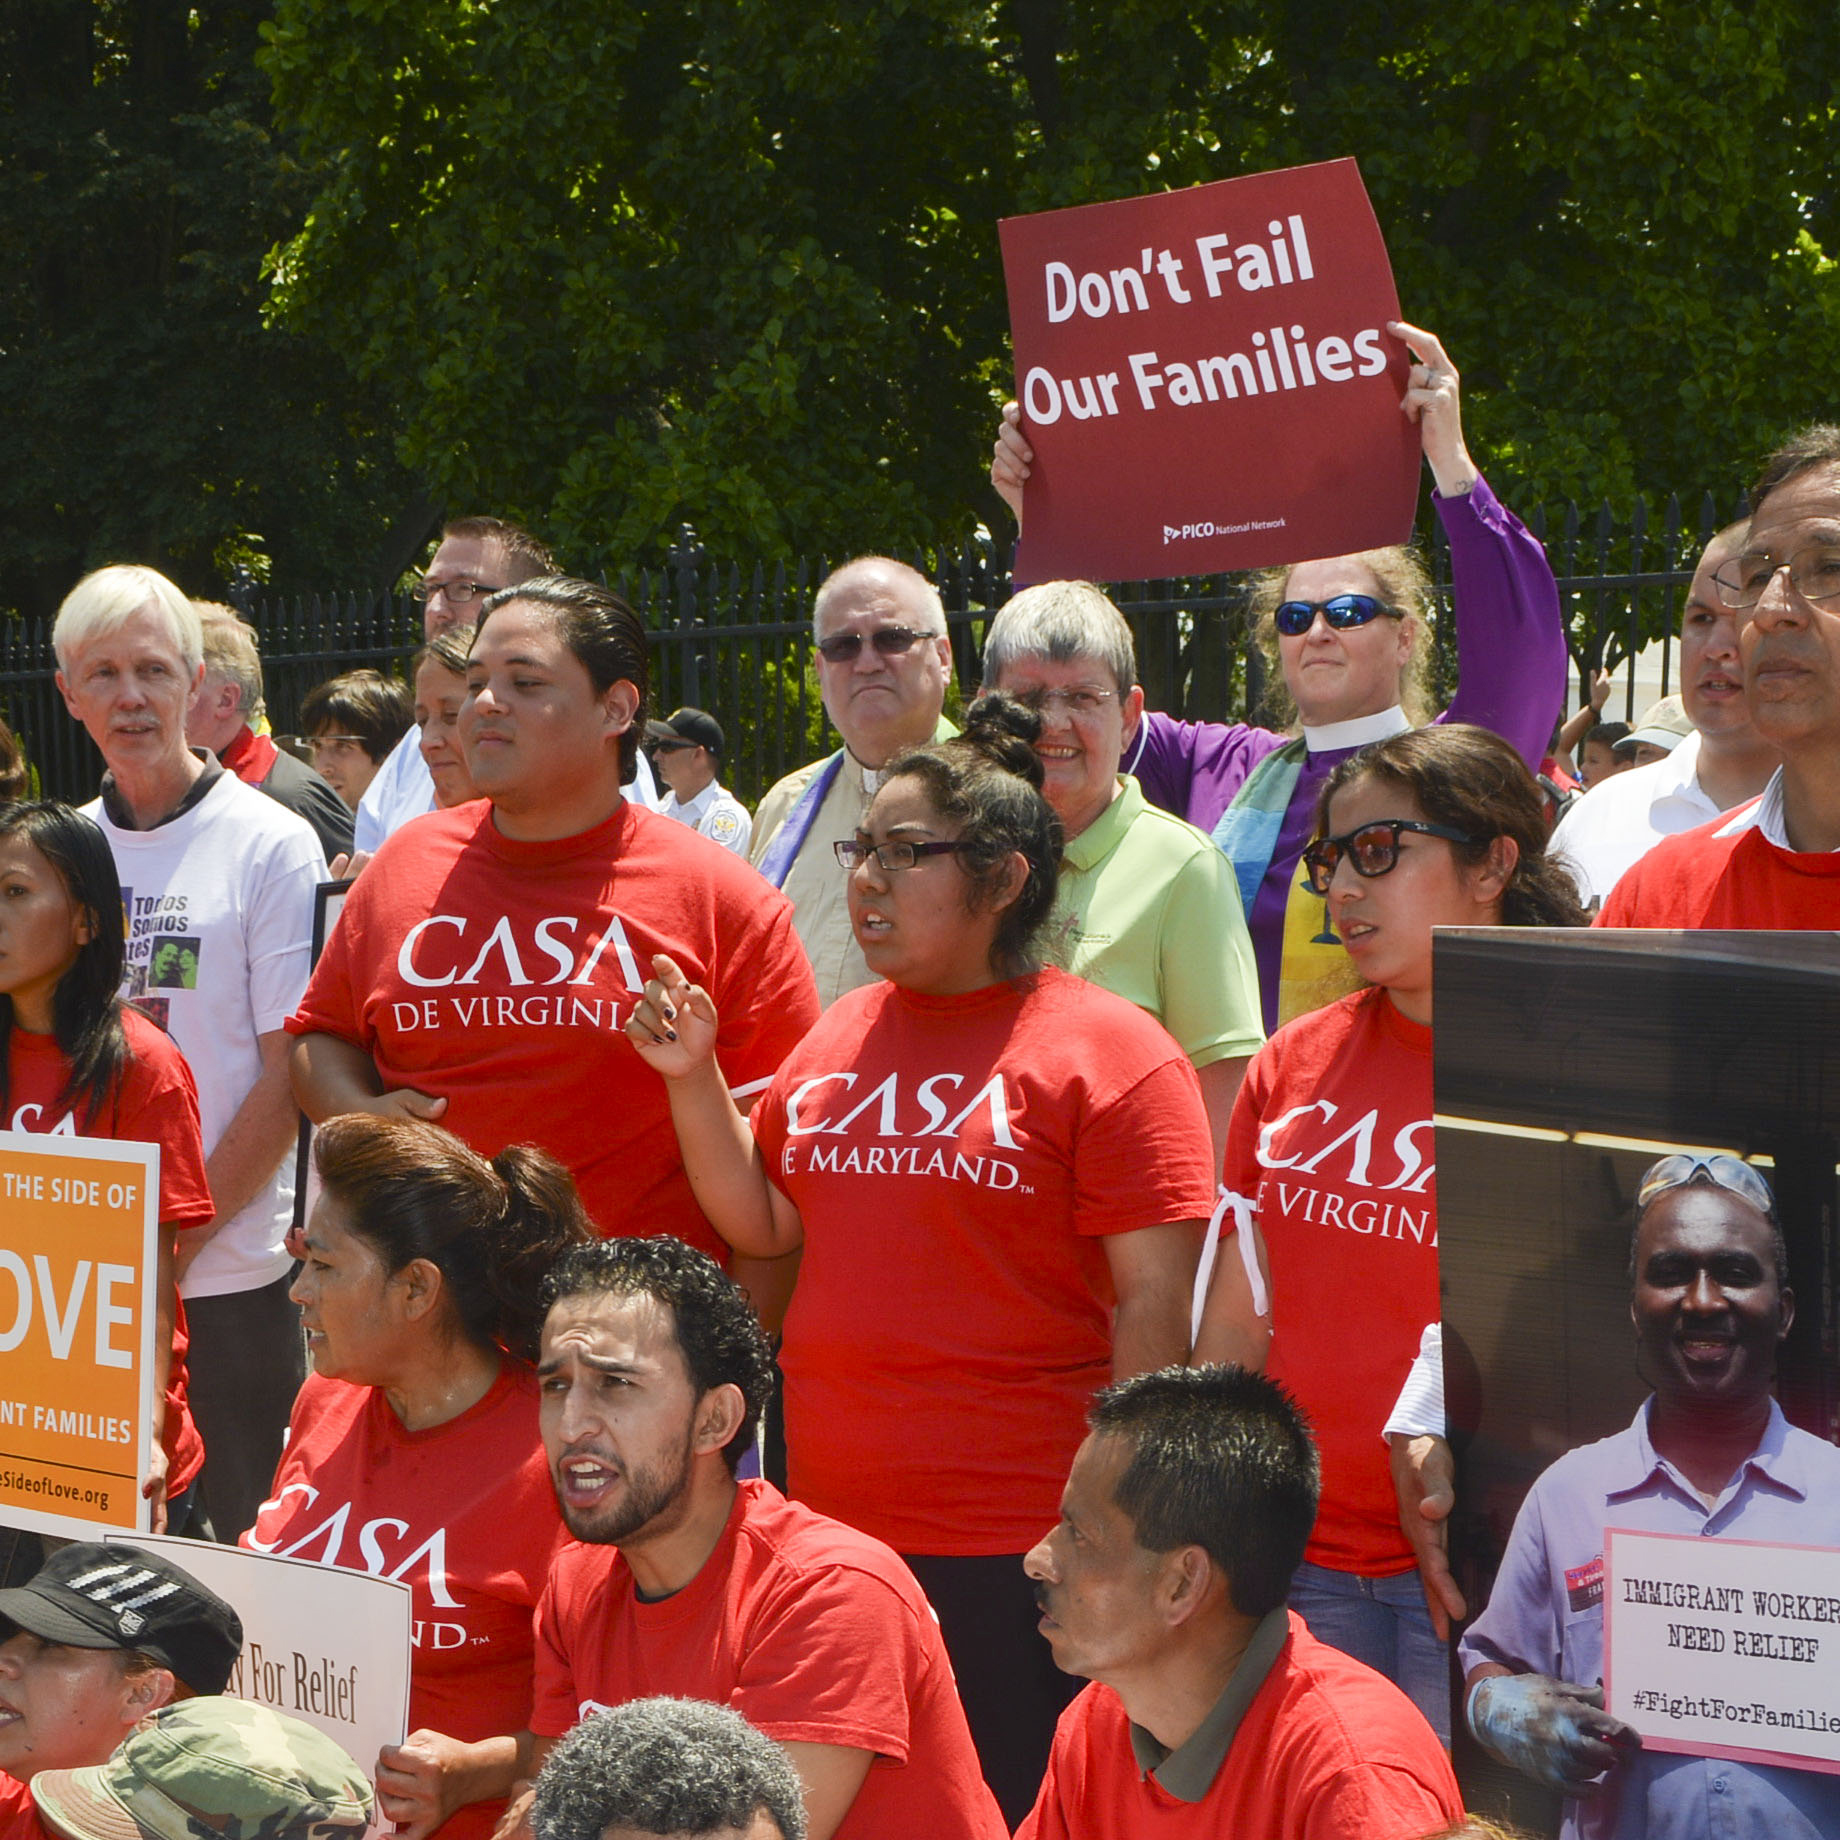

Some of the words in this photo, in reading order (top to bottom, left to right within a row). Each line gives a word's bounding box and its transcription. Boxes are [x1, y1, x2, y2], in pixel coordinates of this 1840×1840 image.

[1045, 247, 1191, 323] Don't
[1196, 214, 1314, 298] Fail
[1024, 366, 1120, 425] Our
[1128, 325, 1387, 411] Families
[1182, 522, 1214, 539] PICO
[1215, 519, 1250, 536] National
[1251, 517, 1286, 531] Network
[397, 915, 645, 995] CASA
[392, 1000, 439, 1032] DE
[449, 995, 628, 1032] VIRGINI
[786, 1072, 1023, 1151] CASA
[809, 1144, 1020, 1190] MARYLAND
[1256, 1100, 1435, 1193] CAS
[3, 1173, 43, 1201] THE
[51, 1178, 99, 1206] SIDE
[107, 1183, 137, 1210] OF
[1277, 1183, 1438, 1248] VIRGIN
[34, 1406, 132, 1445] FAMILIES
[247, 1483, 466, 1608] CASA
[1623, 1578, 1744, 1614] IMMIGRANT
[1668, 1624, 1725, 1653] NEED
[1733, 1630, 1819, 1663] RELIEF
[250, 1643, 286, 1706] For
[293, 1651, 358, 1725] Relief
